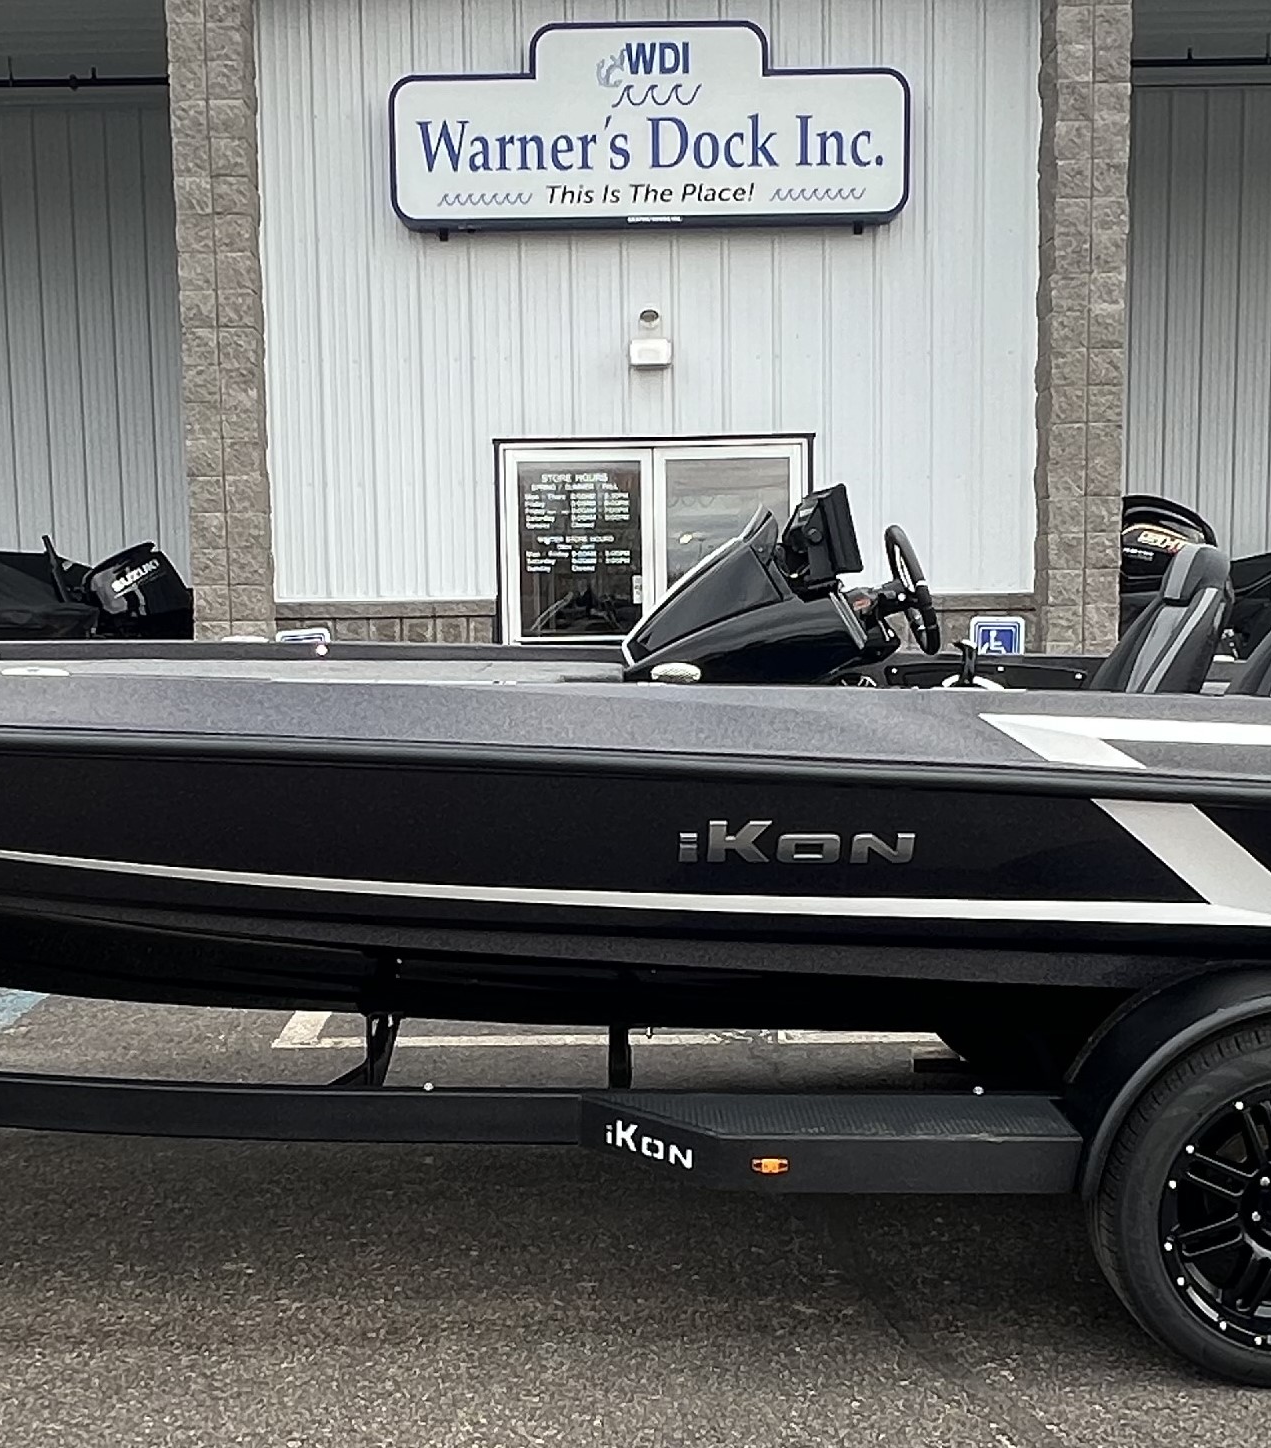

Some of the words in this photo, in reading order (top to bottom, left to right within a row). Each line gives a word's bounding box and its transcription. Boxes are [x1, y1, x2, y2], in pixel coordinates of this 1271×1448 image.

[625, 42, 690, 75] WDI
[416, 115, 631, 173] Warner's
[647, 113, 779, 169] Dock
[795, 114, 884, 167] Inc.
[546, 185, 594, 204] This
[602, 185, 620, 204] Is
[630, 183, 673, 204] The
[681, 183, 755, 203] Place!
